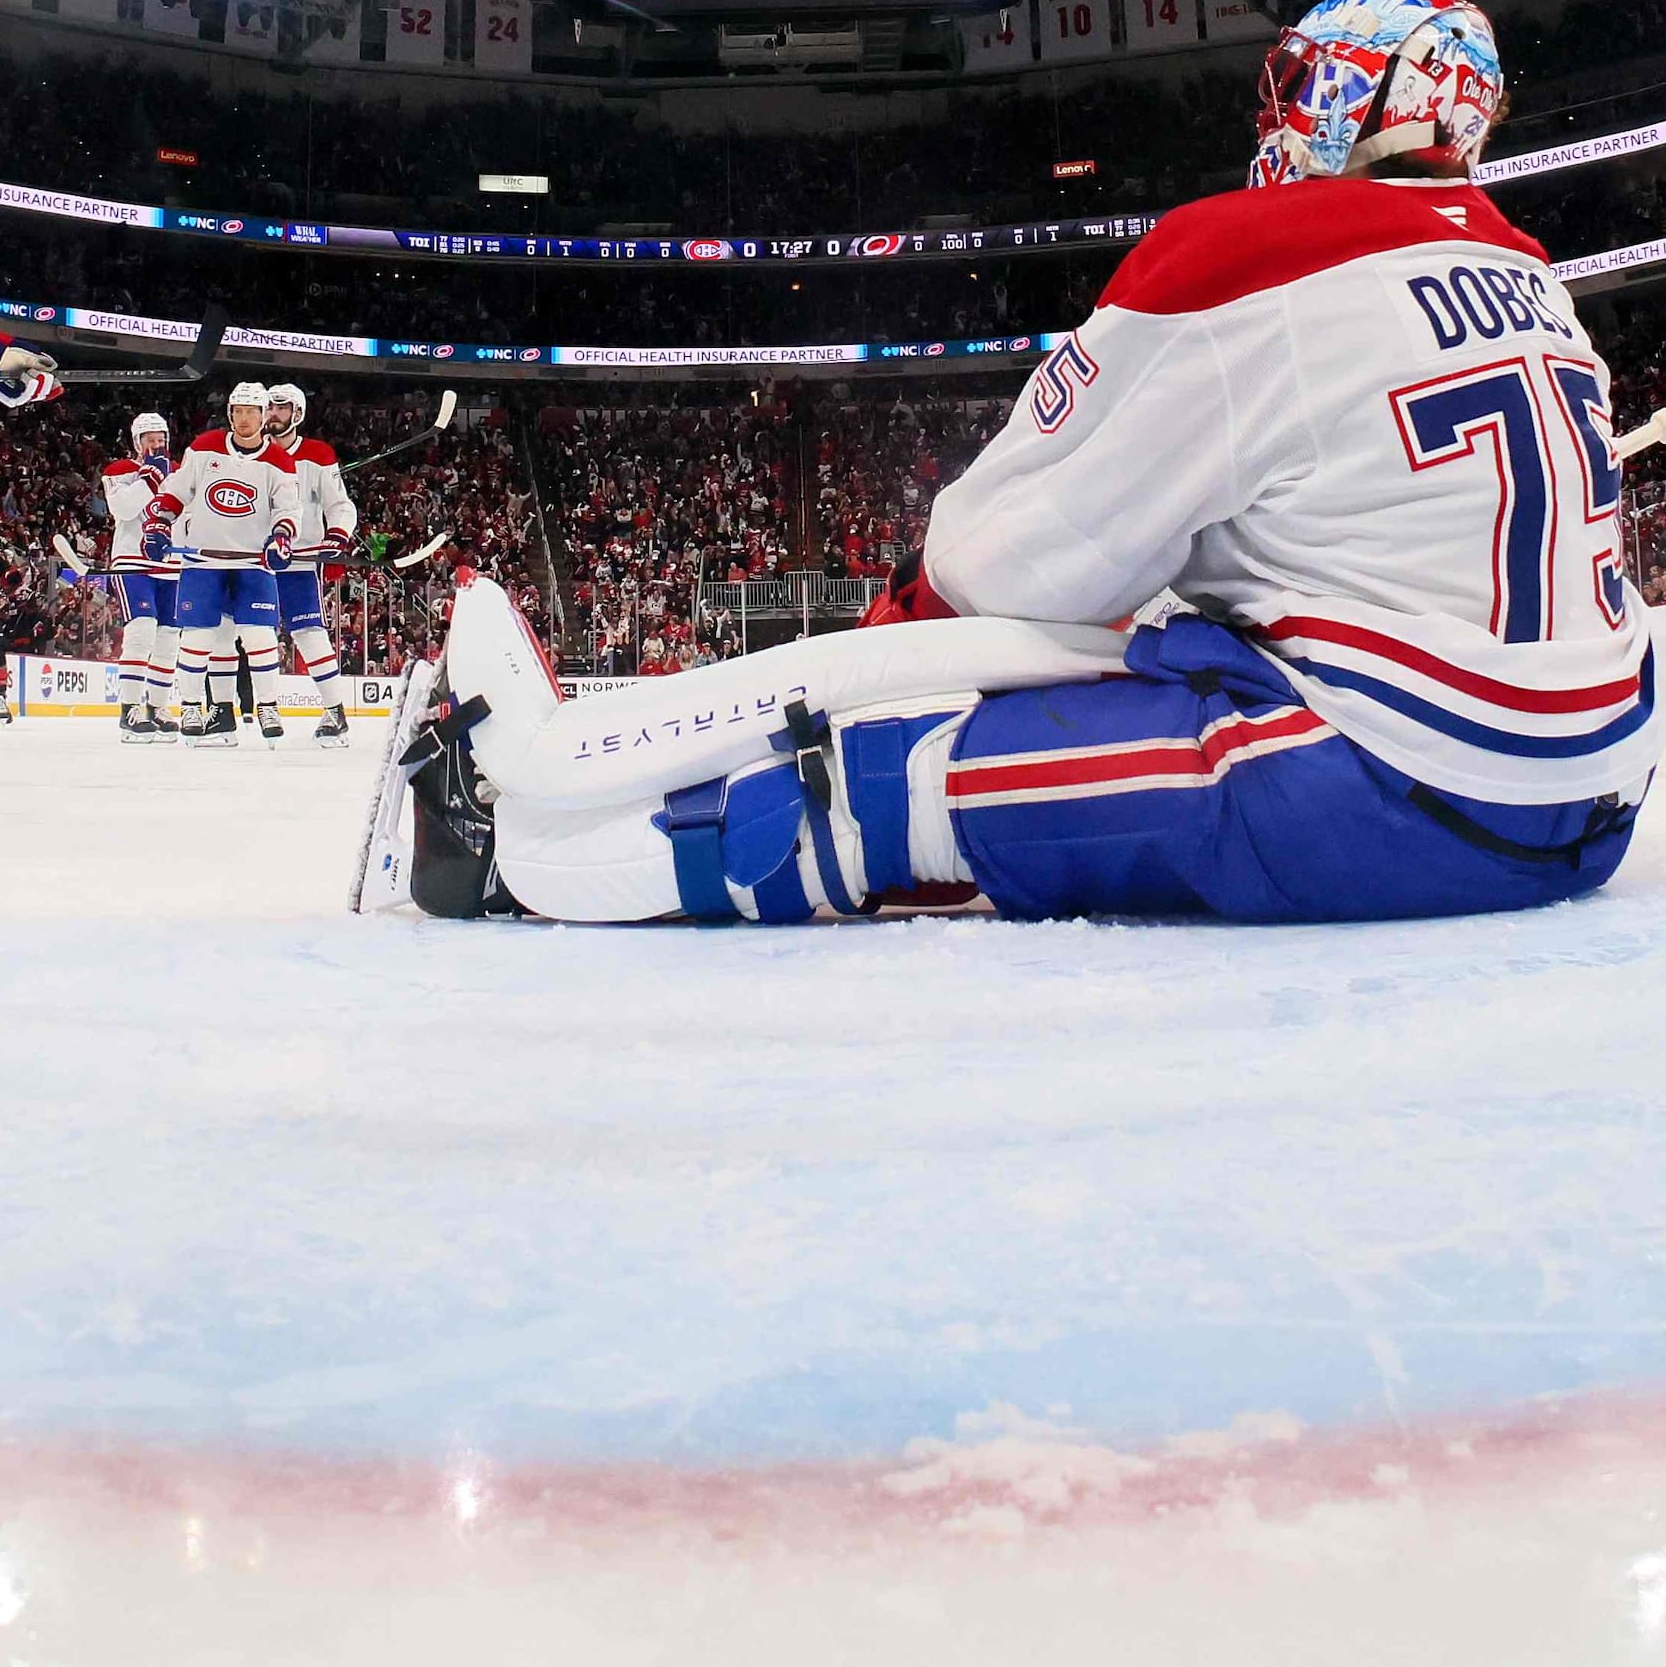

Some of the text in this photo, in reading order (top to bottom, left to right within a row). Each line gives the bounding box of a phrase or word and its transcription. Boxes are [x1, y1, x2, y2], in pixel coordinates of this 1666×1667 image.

[400, 7, 432, 35] 52
[1057, 3, 1093, 38] 10
[488, 16, 519, 42] 24
[160, 149, 196, 164] Lenovo
[1507, 128, 1659, 173] INSURANCE PARTNER
[74, 199, 139, 222] PARTNER
[197, 217, 216, 231] NC
[1084, 224, 1105, 236] TOI
[409, 236, 430, 248] TOI
[771, 240, 813, 255] 17:27
[827, 240, 841, 255] 0
[941, 239, 963, 250] 100
[743, 242, 757, 258] 0
[1550, 256, 1606, 279] OFFICIAL
[1609, 243, 1660, 267] HEALTH
[10, 304, 27, 318] NC
[88, 313, 354, 353] OFFICIAL SURANCE PARTNER
[409, 344, 427, 357] NC
[493, 349, 513, 360] NC
[574, 348, 844, 363] OFFICIAL HEALTH INSURANCE PARTNER
[1388, 353, 1625, 645] 75
[57, 671, 88, 693] PEPSI
